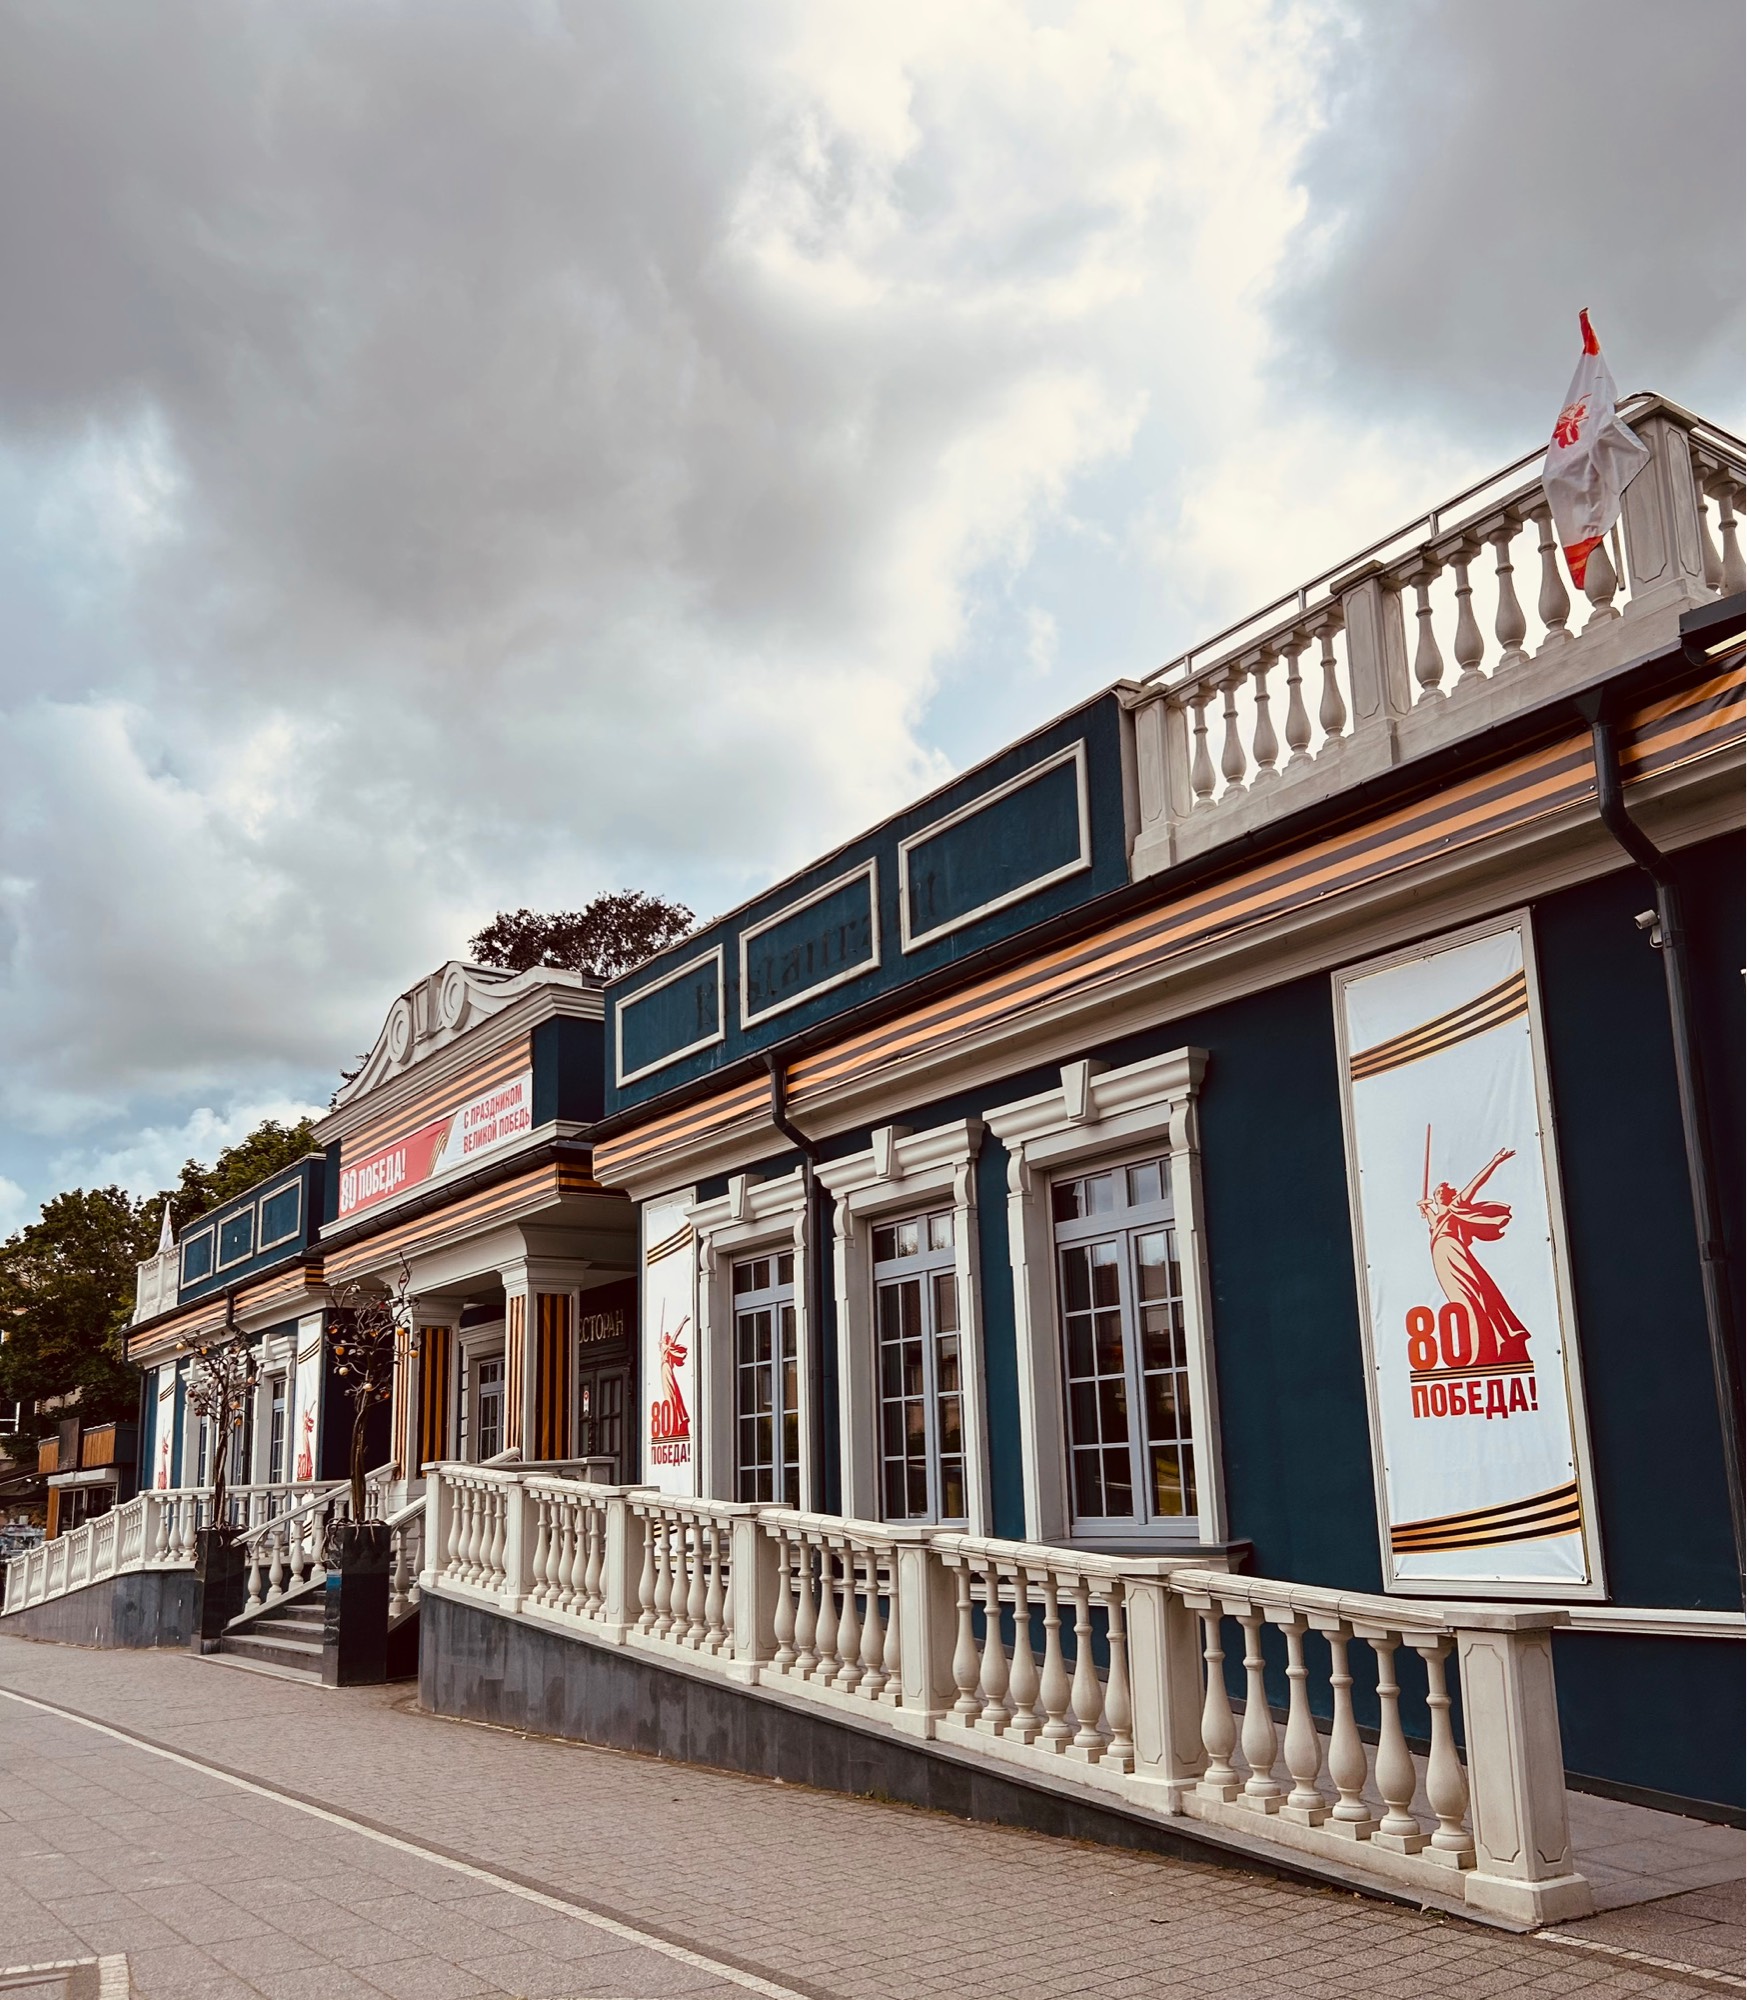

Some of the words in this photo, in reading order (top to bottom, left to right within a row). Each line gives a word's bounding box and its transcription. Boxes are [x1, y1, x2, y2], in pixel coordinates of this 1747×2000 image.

[464, 1110, 469, 1130] С
[471, 1083, 523, 1126] ПРАЗДНИКОМ
[463, 1119, 498, 1154] ВЕЛИКОЙ
[340, 1168, 357, 1213] 80
[358, 1148, 406, 1194] ПОБЕДА!
[579, 1308, 624, 1344] ЕСТОРАН
[1405, 1301, 1473, 1371] 80
[651, 1399, 671, 1439] 80
[1410, 1376, 1539, 1420] ПОБЕДА!
[651, 1442, 691, 1467] ПОБЕДА!
